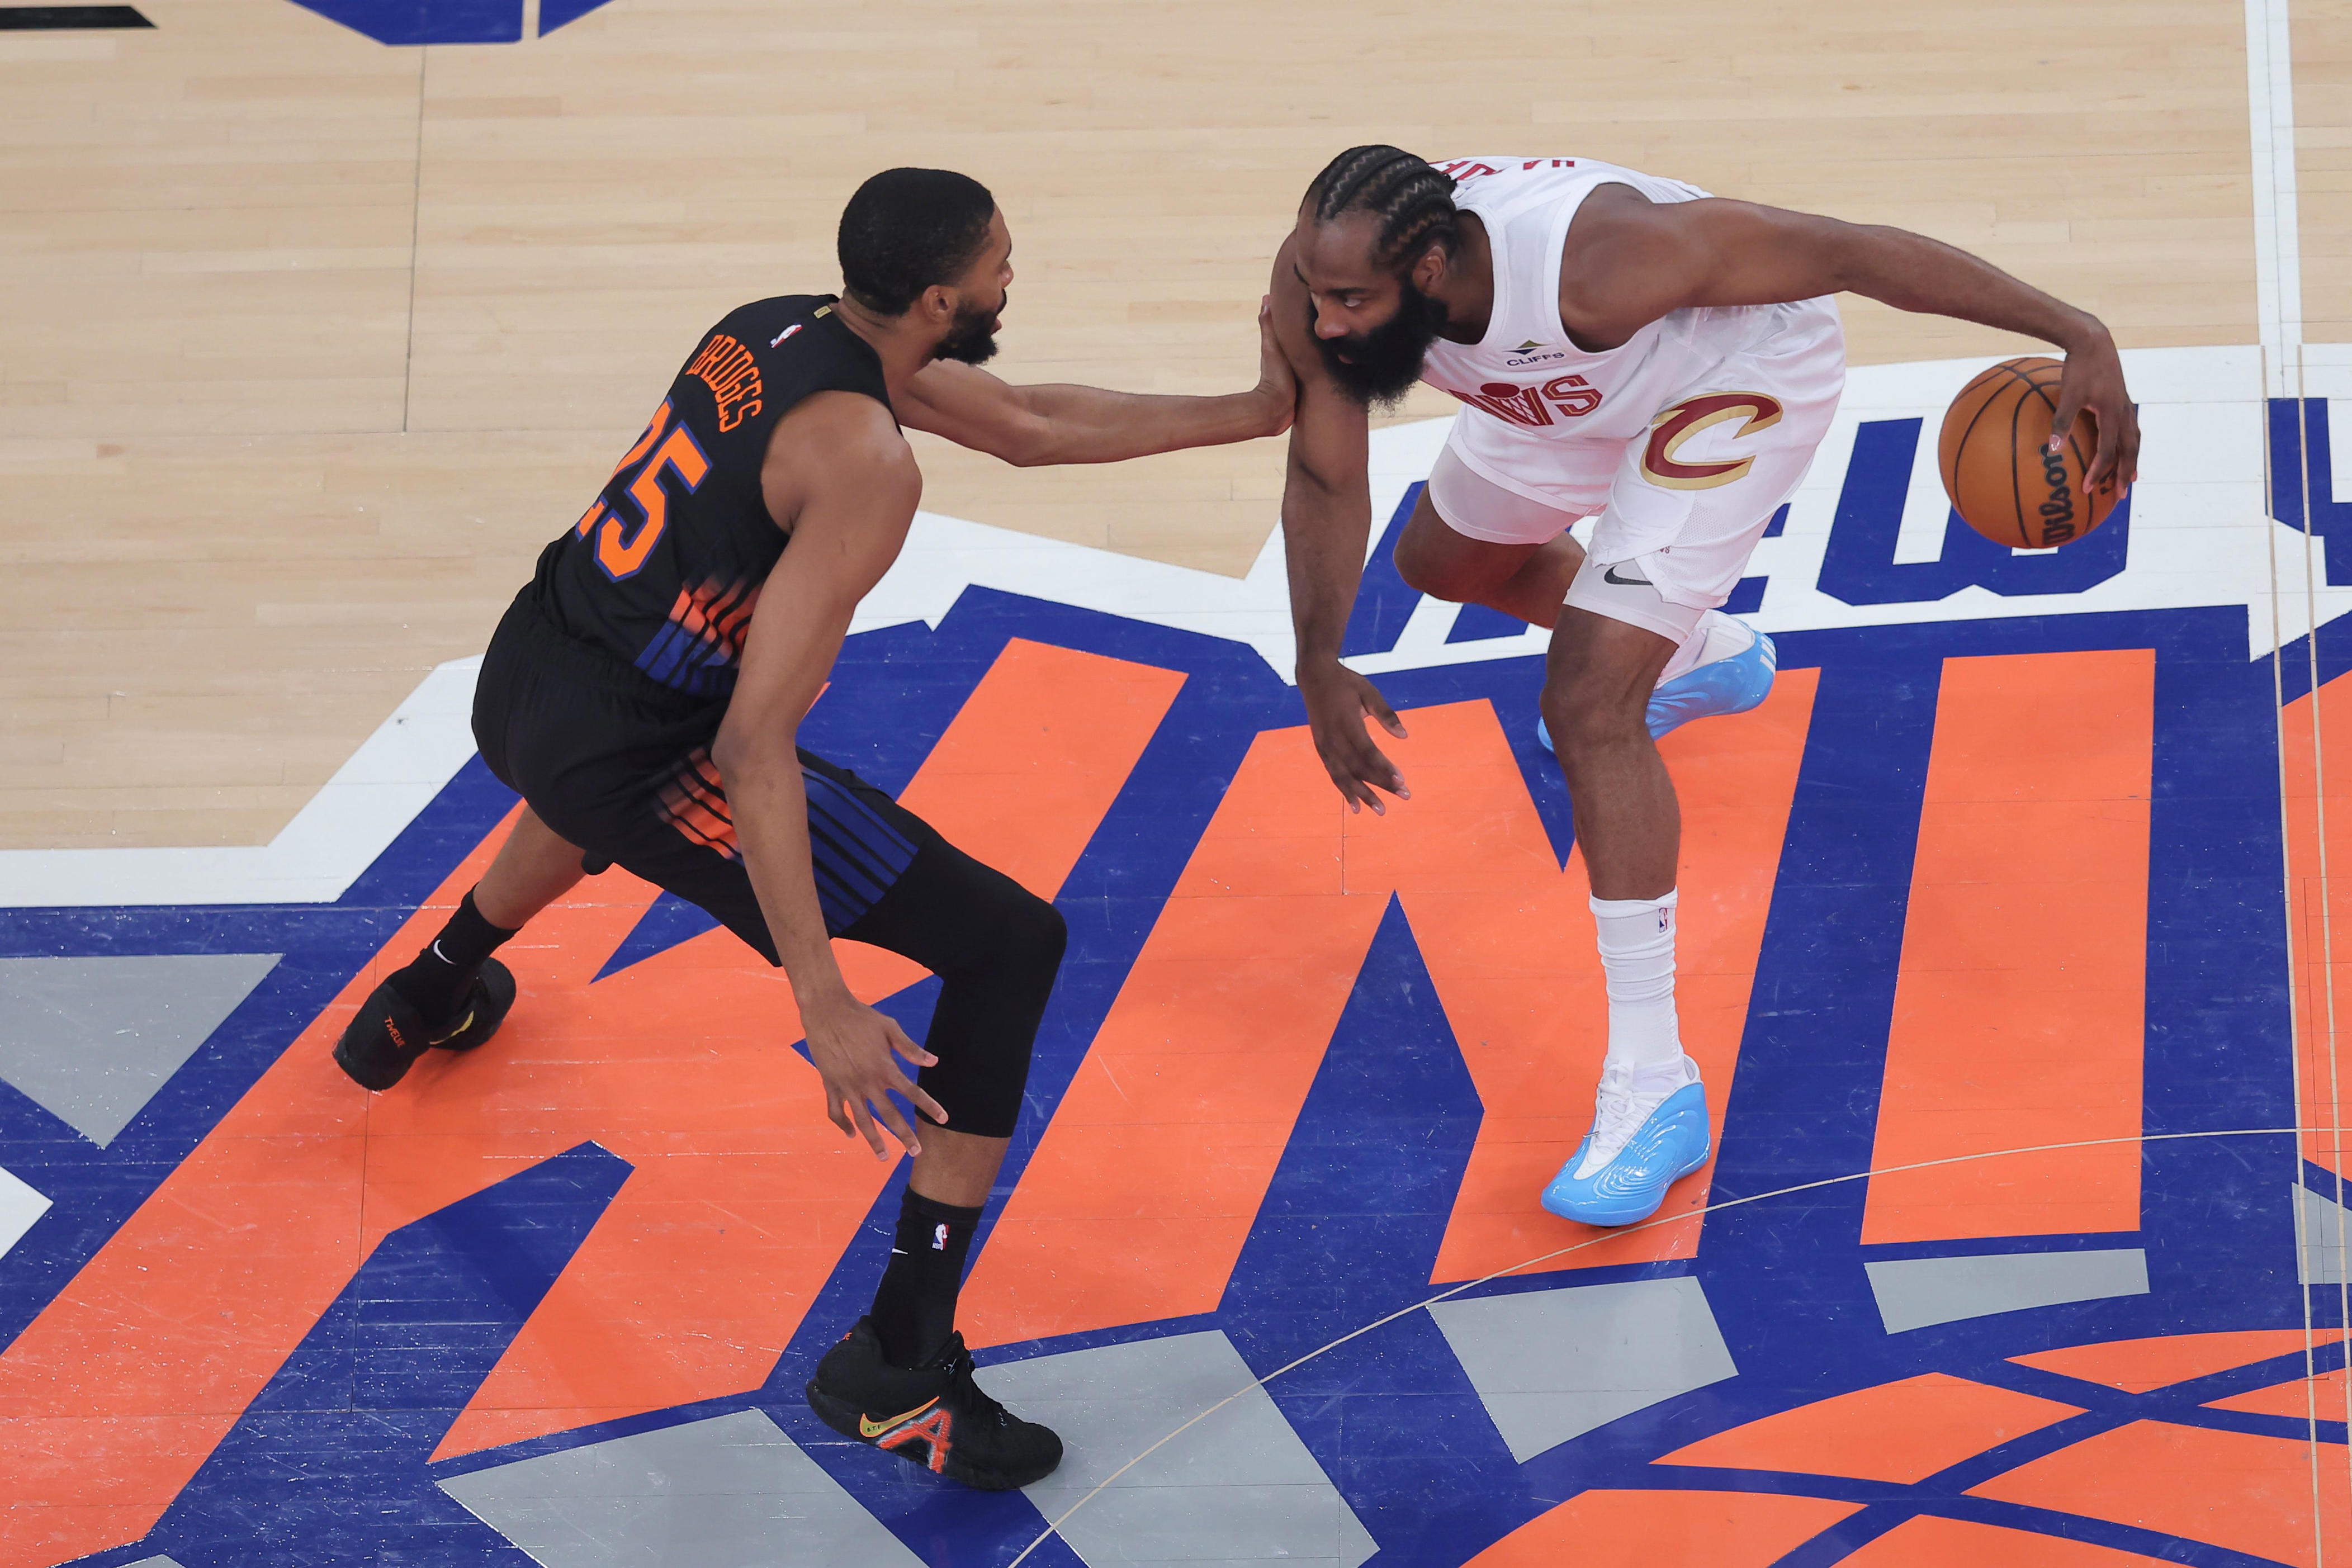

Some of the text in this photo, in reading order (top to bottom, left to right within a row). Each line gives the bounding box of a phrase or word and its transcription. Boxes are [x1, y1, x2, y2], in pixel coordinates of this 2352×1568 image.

[684, 334, 763, 433] BRIDGES
[1506, 352, 1565, 366] CLIFFS
[1639, 391, 1783, 490] C
[2038, 442, 2076, 546] Wilson
